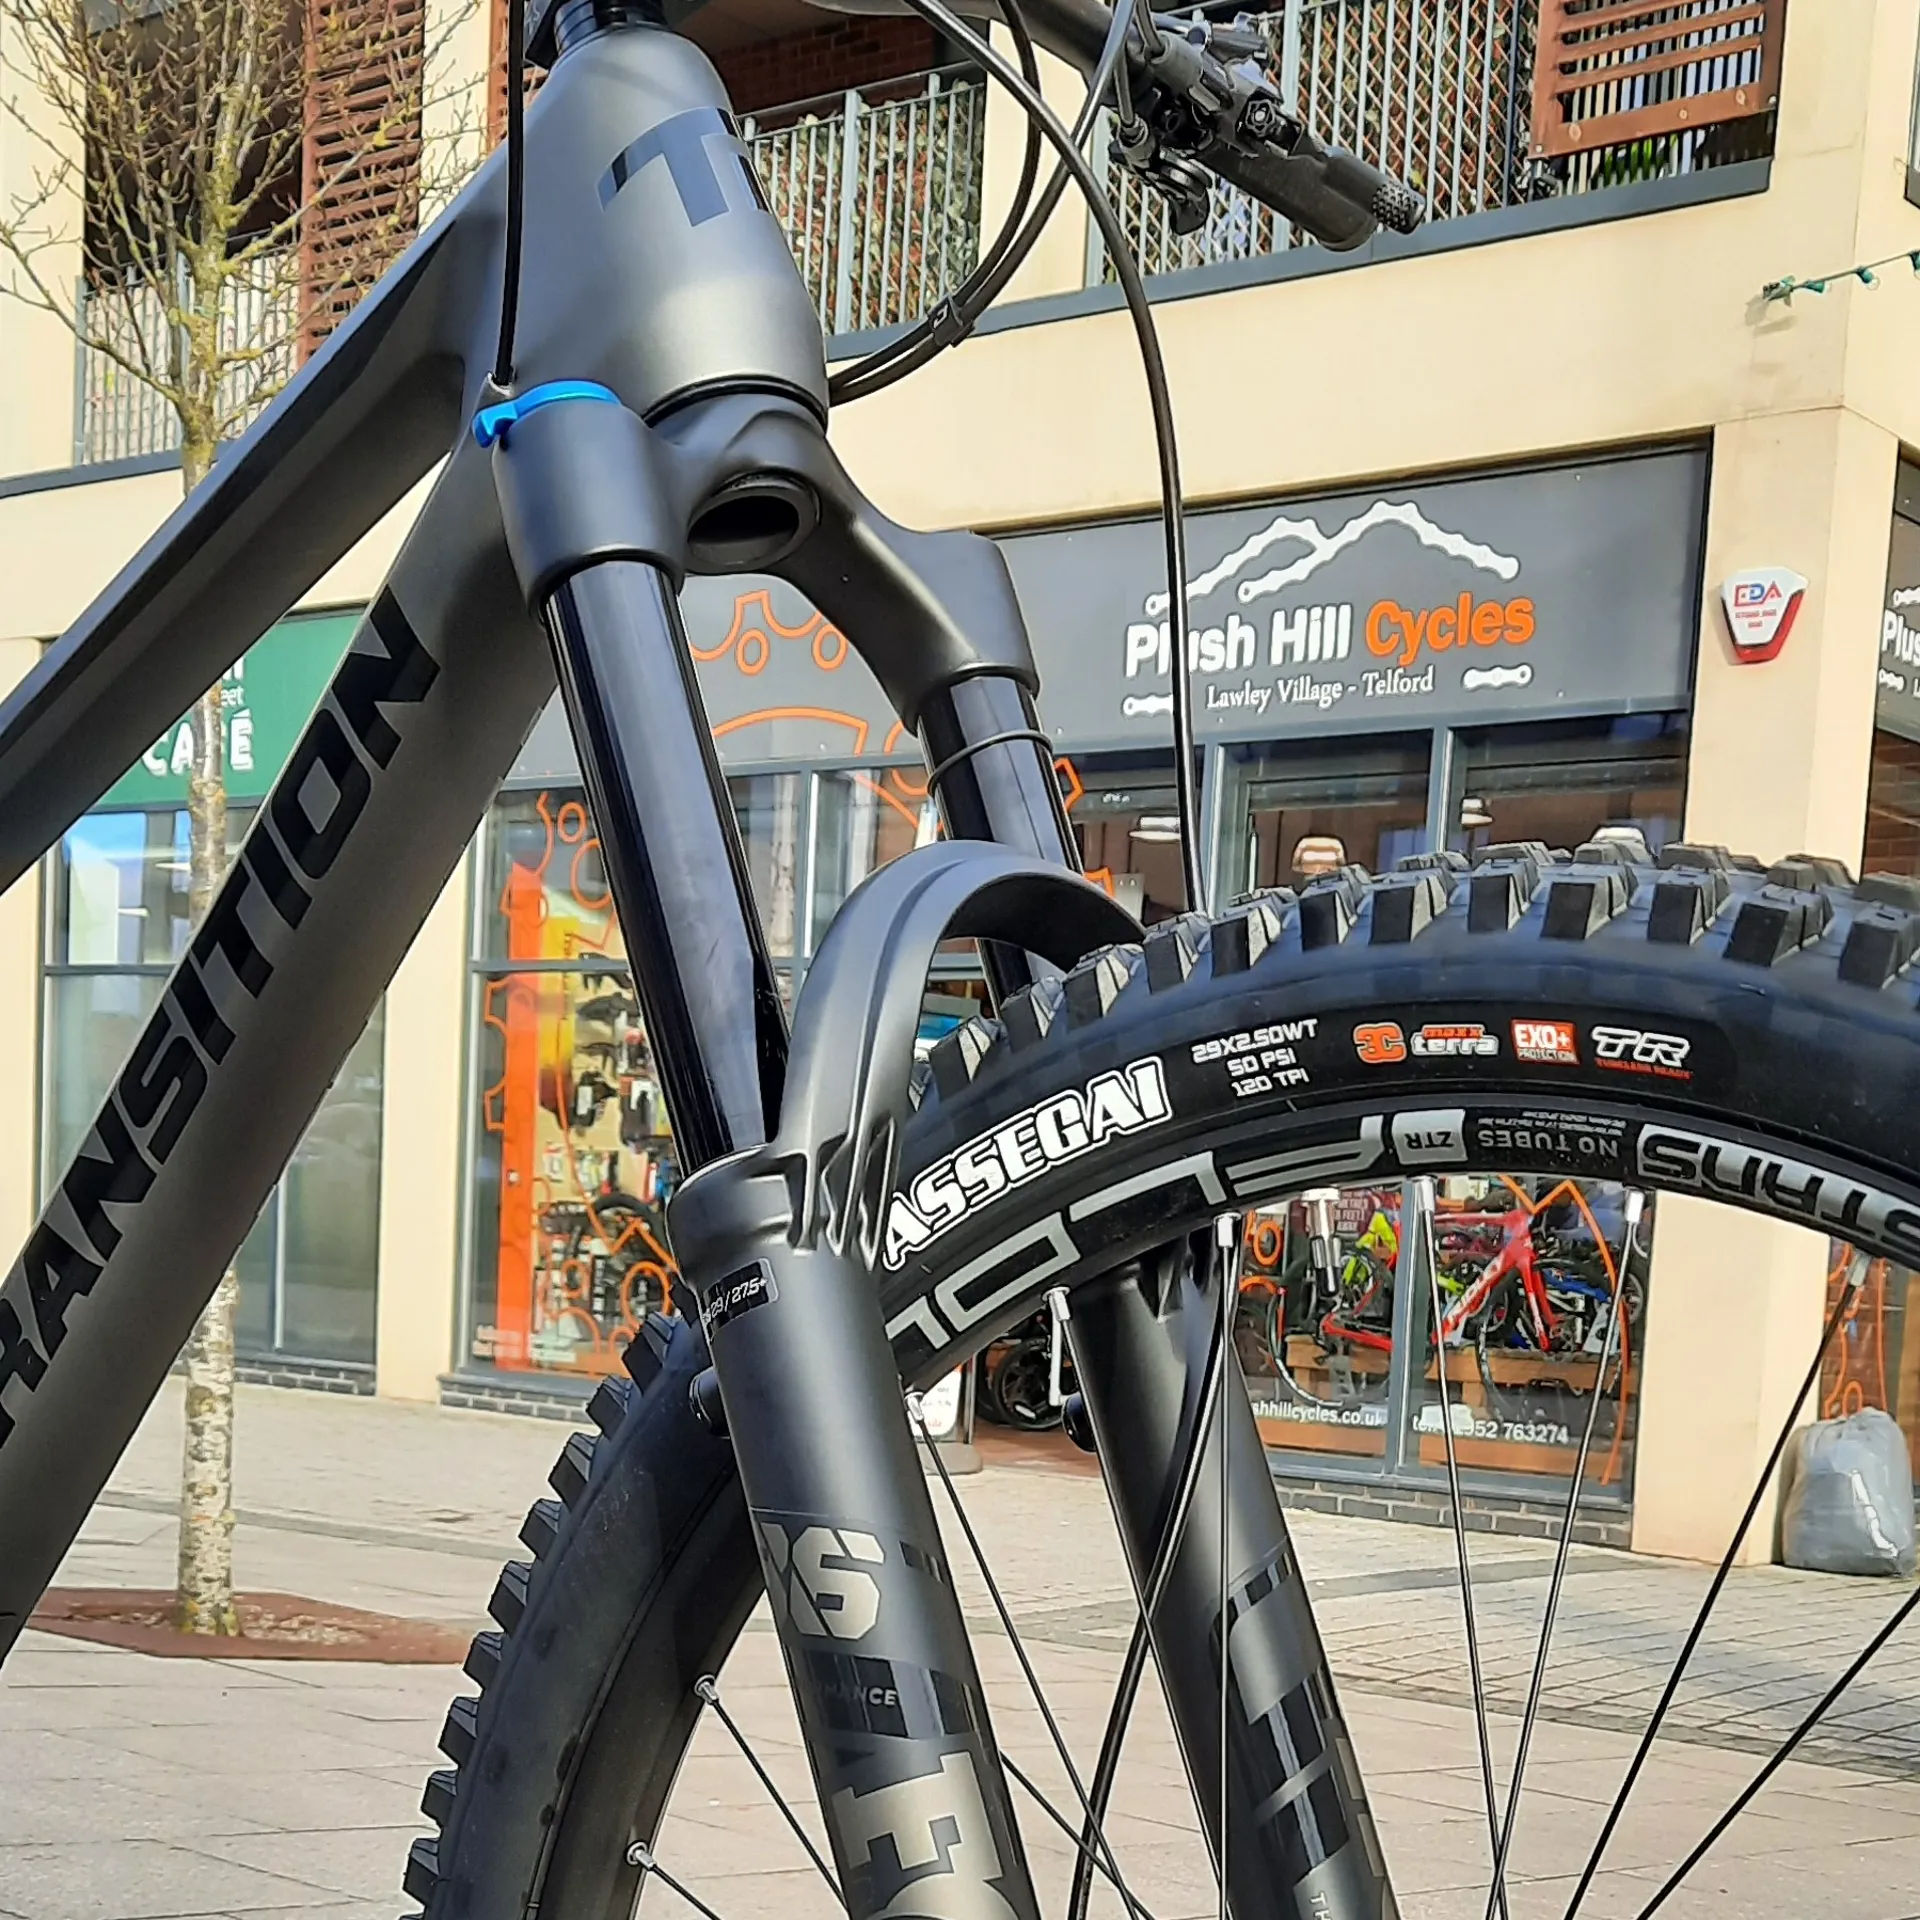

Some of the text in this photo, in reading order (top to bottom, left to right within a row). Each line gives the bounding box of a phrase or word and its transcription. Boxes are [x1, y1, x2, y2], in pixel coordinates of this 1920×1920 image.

[1270, 602, 1353, 667] Hill
[1366, 590, 1536, 668] Cycles
[1207, 679, 1272, 715] Lawley
[1277, 674, 1344, 711] Village
[1362, 664, 1435, 698] Telford
[141, 707, 254, 777] CAÉ
[0, 586, 440, 1449] RANSITION
[1514, 1023, 1572, 1049] EXO+
[1591, 1026, 1691, 1068] TR
[1227, 1047, 1297, 1077] 50 PSI
[1231, 1067, 1310, 1097] 120 TPI
[1404, 1131, 1456, 1150] ZTR
[1478, 1129, 1572, 1152] TUBES
[1578, 1136, 1618, 1158] NO
[882, 1055, 1173, 1272] ASSEGAI
[1252, 1401, 1386, 1427] shhillcycles.co.uk
[1502, 1421, 1570, 1445] 763274
